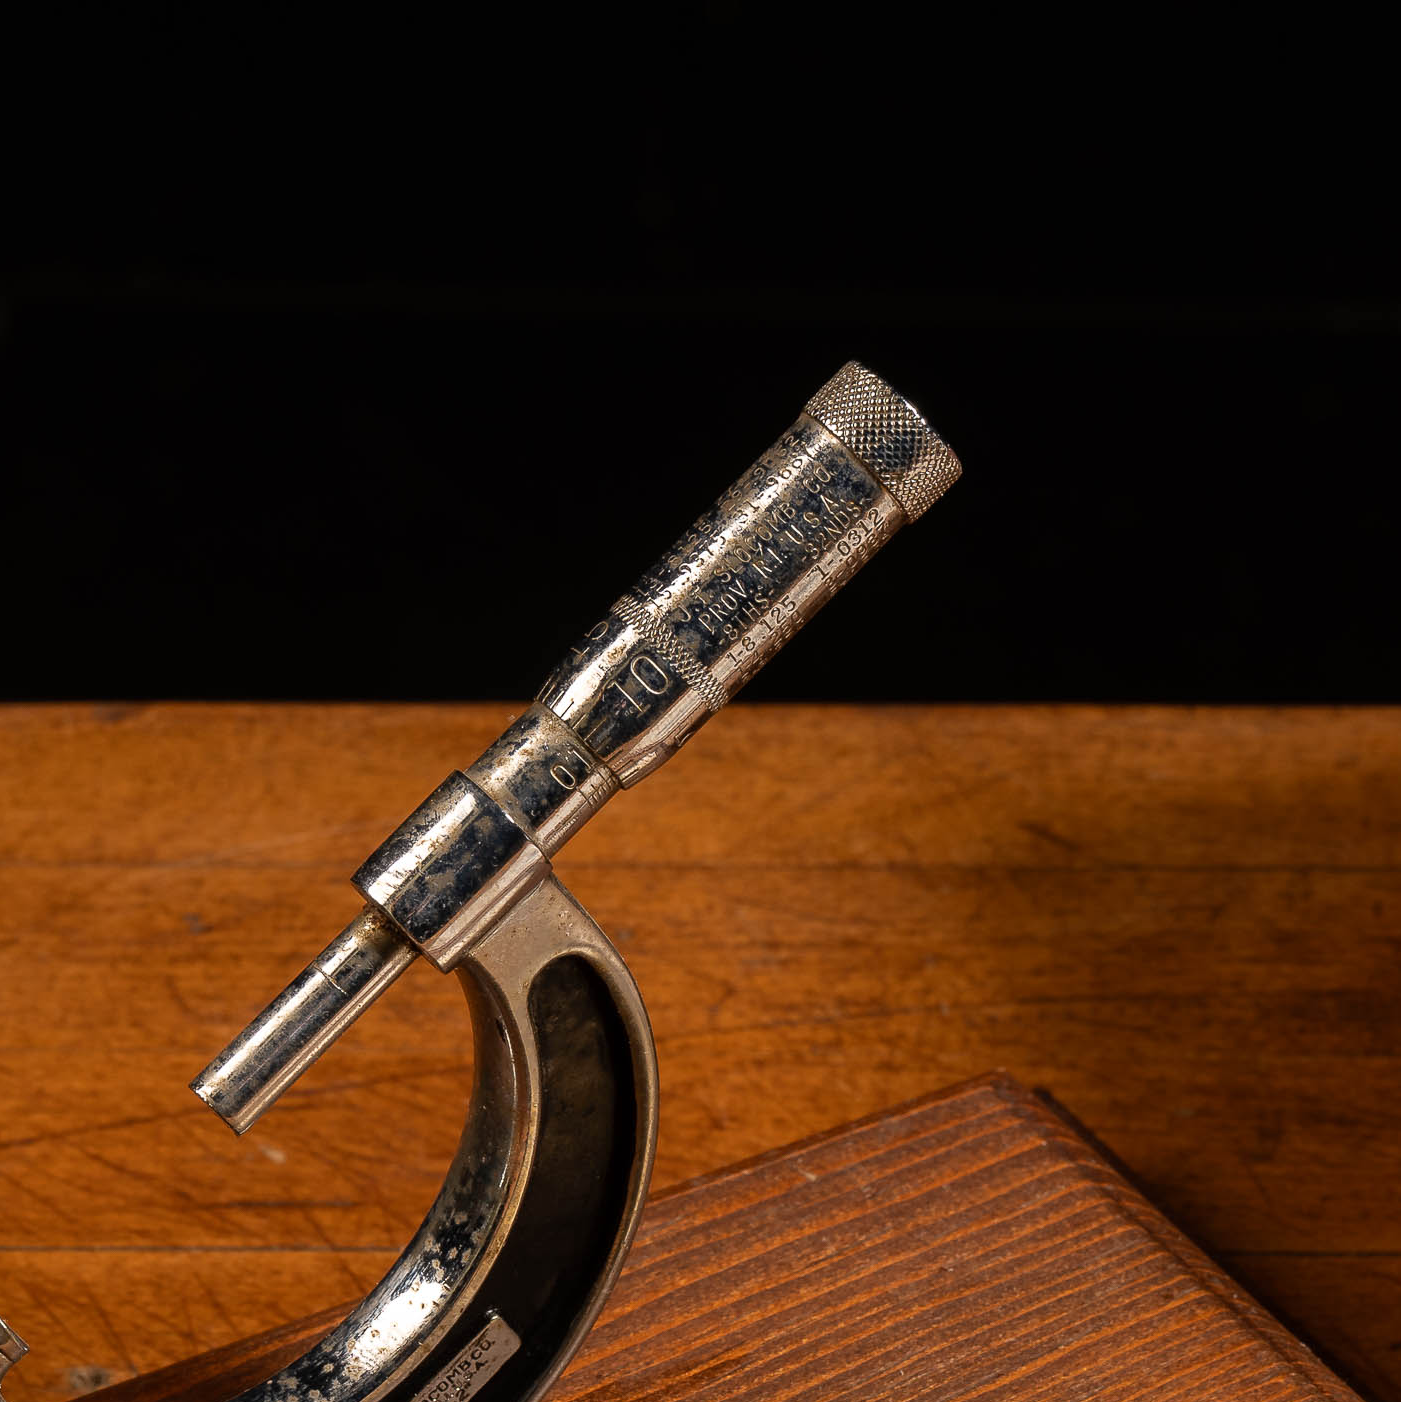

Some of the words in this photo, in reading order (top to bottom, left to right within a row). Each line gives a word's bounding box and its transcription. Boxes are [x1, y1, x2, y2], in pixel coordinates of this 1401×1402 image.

[717, 505, 798, 585] SLOCOMB
[698, 578, 753, 633] PROV.
[609, 653, 673, 718] 10
